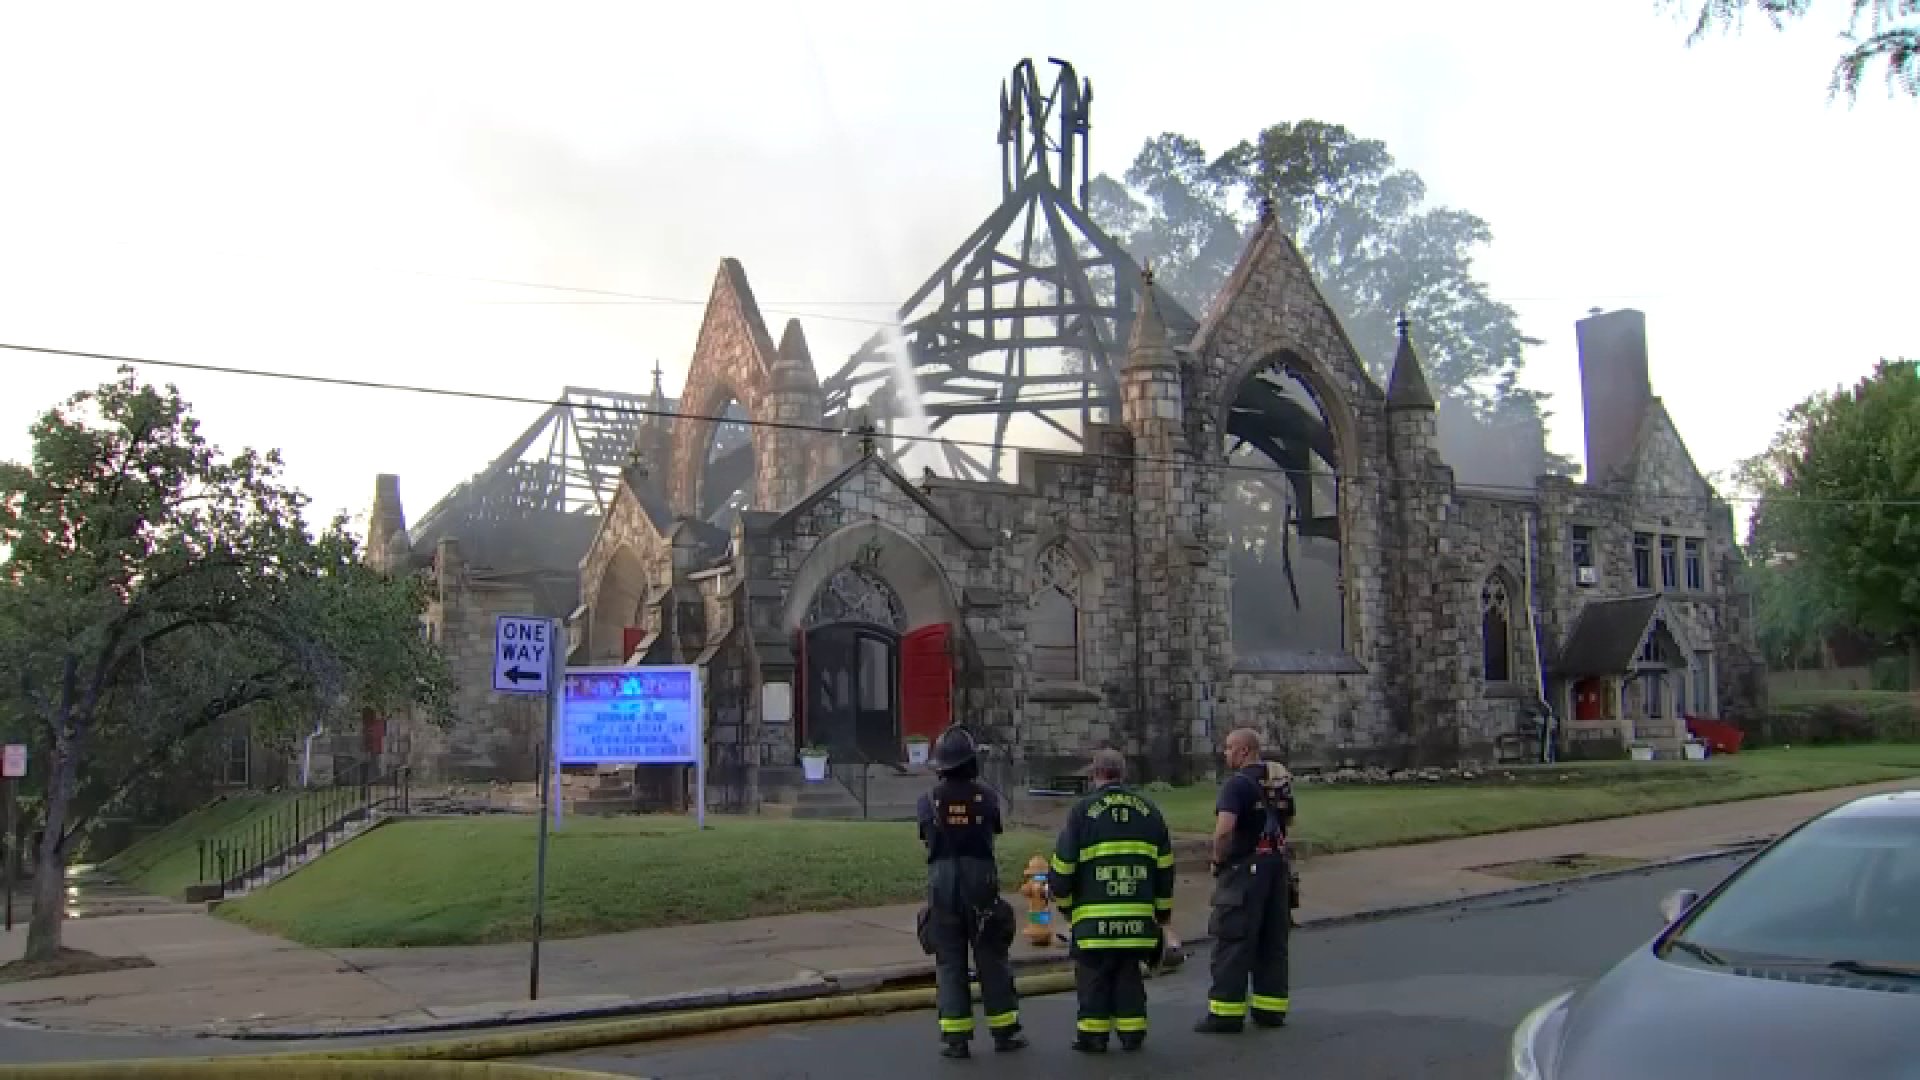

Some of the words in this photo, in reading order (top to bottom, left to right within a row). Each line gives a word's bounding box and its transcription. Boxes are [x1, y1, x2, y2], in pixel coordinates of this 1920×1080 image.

[503, 623, 544, 642] ONE
[502, 644, 545, 662] WAY
[1106, 881, 1137, 897] CHIEF
